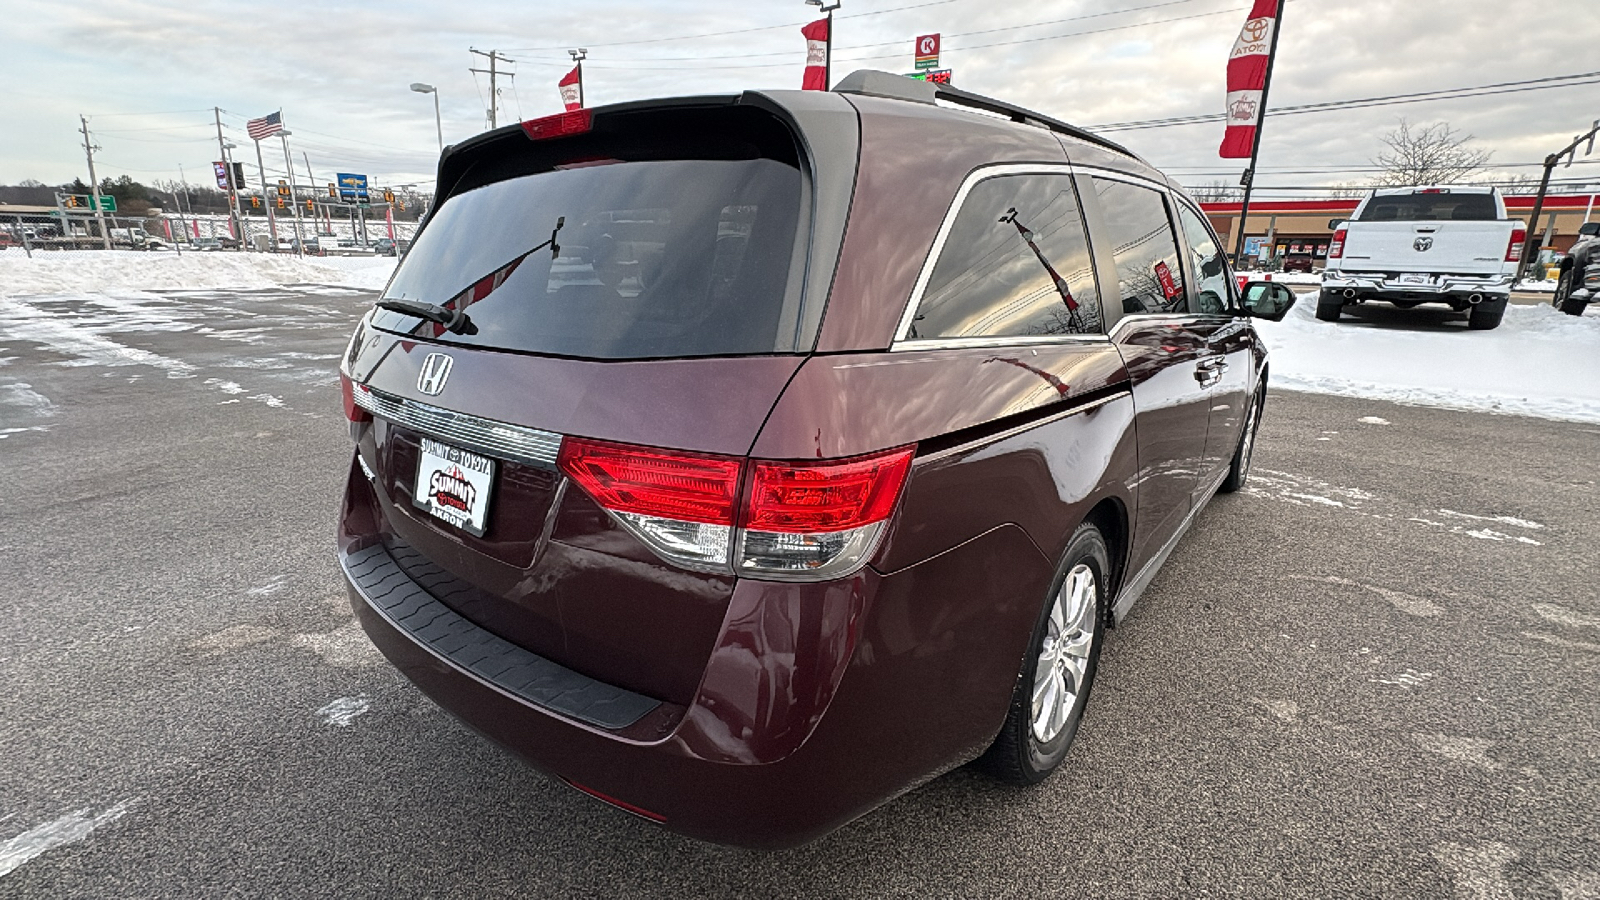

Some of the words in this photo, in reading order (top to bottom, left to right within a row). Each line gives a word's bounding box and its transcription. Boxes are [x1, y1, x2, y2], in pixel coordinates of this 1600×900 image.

[924, 39, 933, 52] K
[421, 437, 450, 460] SUMMIT
[460, 451, 491, 475] TOYOTA
[430, 471, 475, 512] SUMMIT
[447, 497, 466, 510] TOYOTA
[430, 507, 463, 529] AKRON
